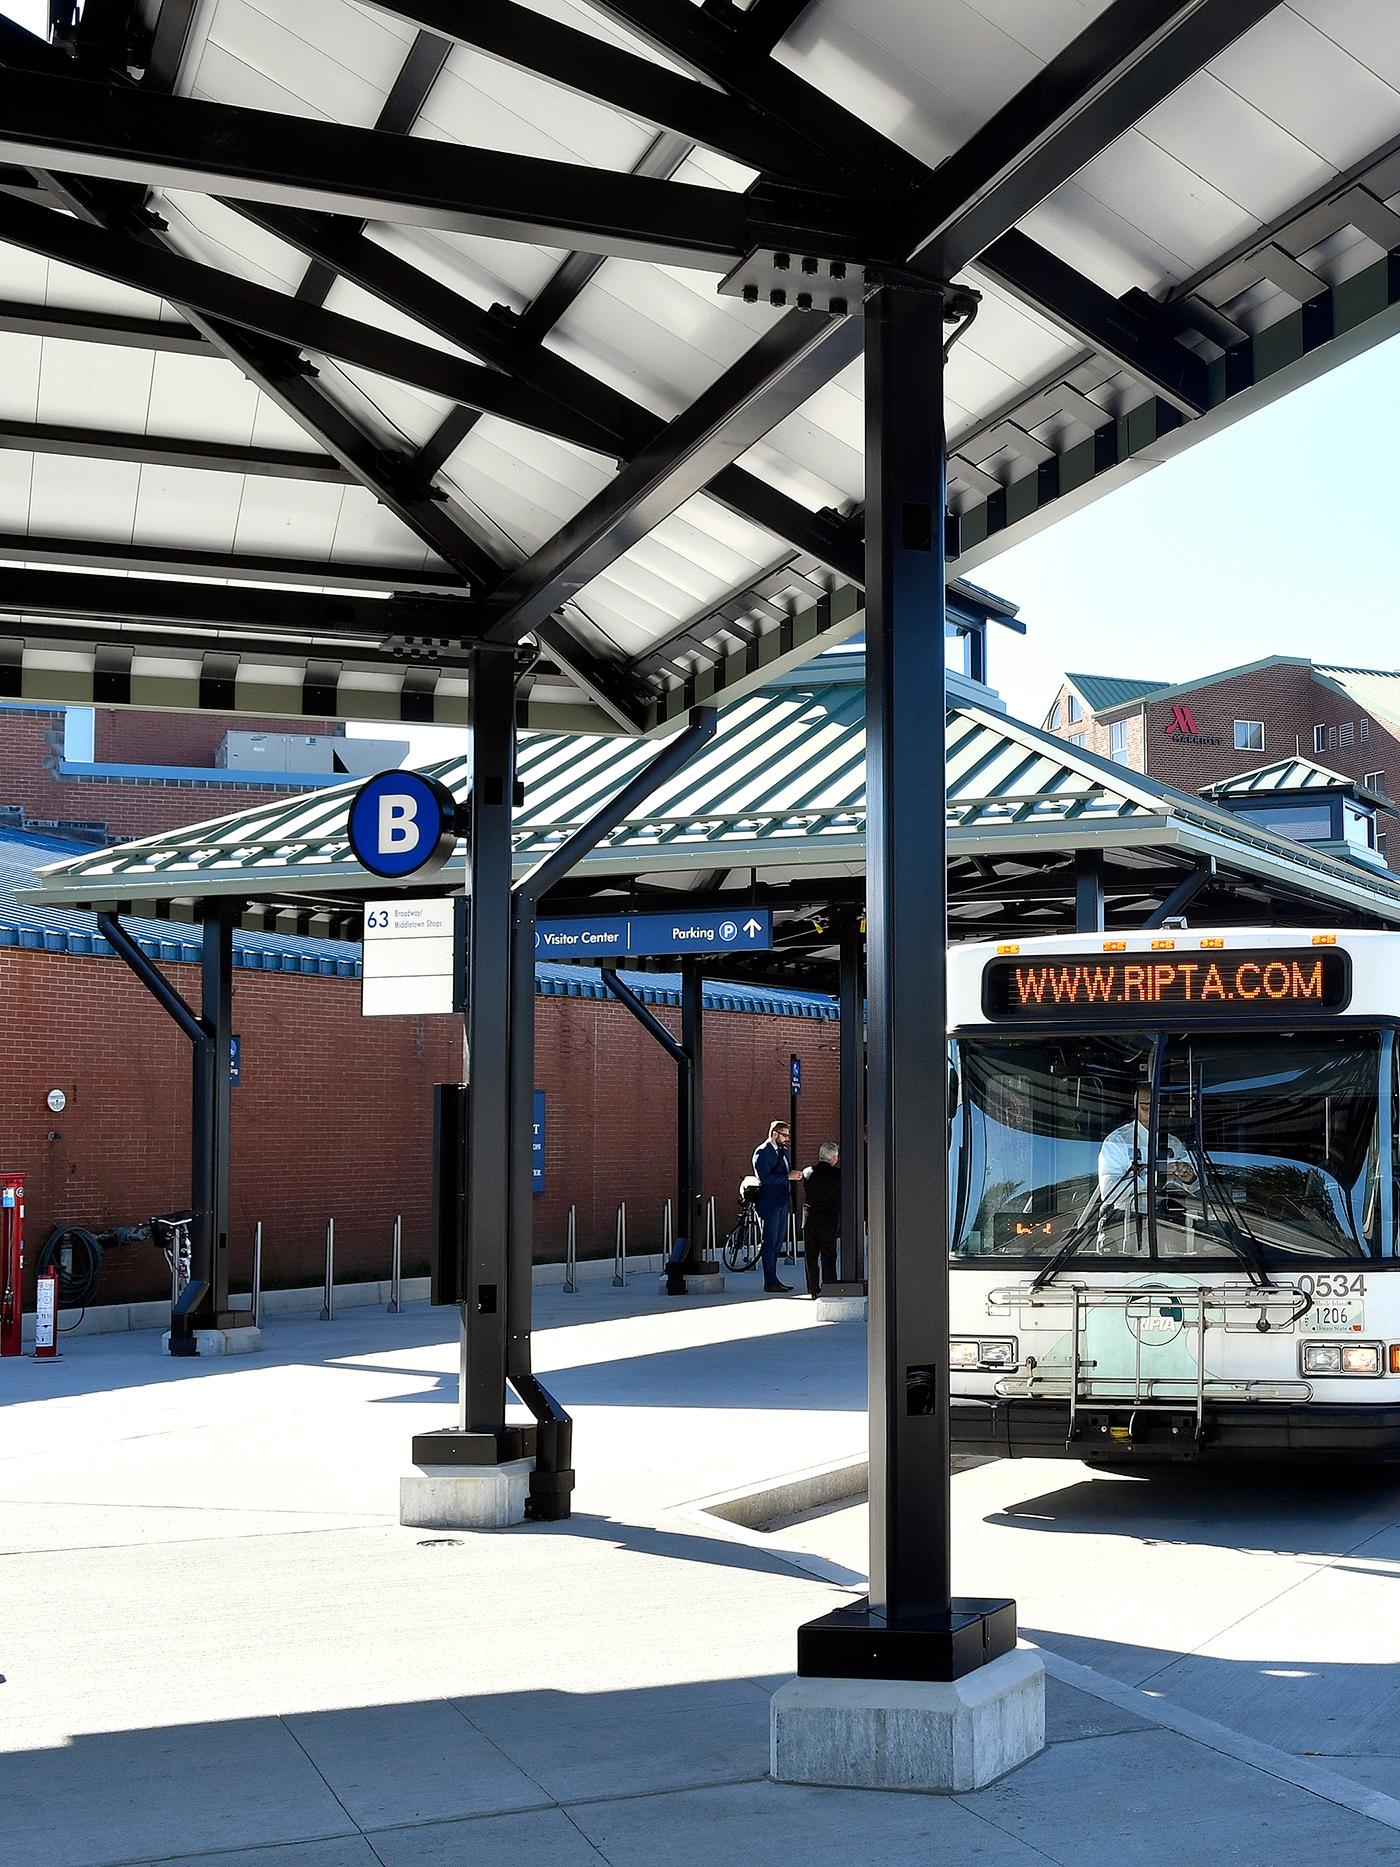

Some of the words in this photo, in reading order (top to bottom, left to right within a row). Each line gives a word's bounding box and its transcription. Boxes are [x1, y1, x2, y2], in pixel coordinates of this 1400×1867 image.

[378, 794, 420, 854] B
[367, 910, 389, 928] 63
[394, 920, 425, 928] Middletown
[426, 919, 443, 928] Shops
[543, 933, 579, 945] Visitor
[581, 931, 620, 944] Center
[672, 926, 715, 941] Parking
[1015, 961, 1322, 1003] WWW.RIPTA.COM
[1298, 1274, 1365, 1297] 0534
[1316, 1308, 1348, 1324] 1206
